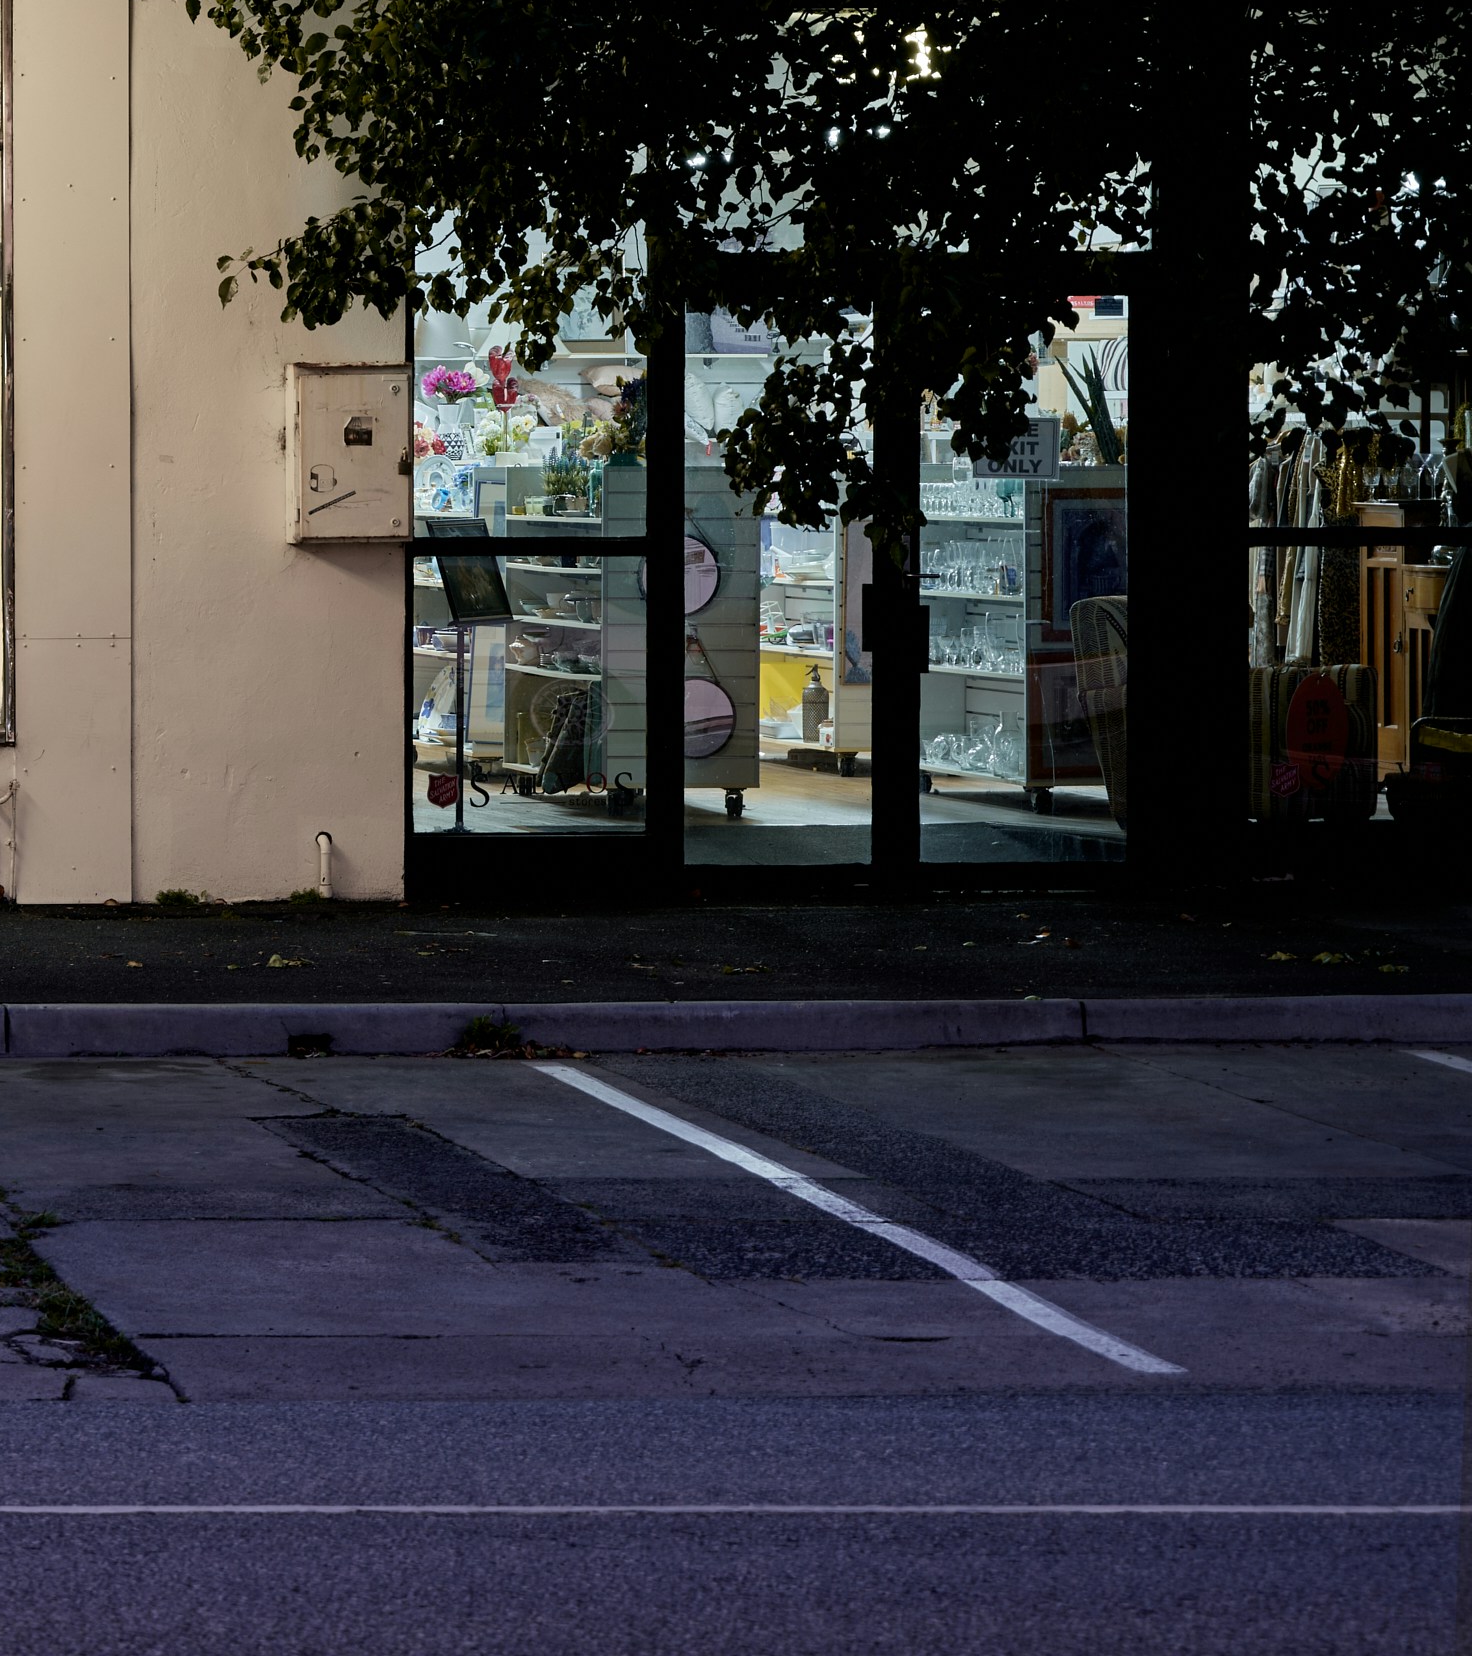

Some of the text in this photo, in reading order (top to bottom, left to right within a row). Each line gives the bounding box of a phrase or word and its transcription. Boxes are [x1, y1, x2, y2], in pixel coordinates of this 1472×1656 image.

[1003, 441, 1039, 455] XIT
[987, 459, 1043, 473] ONLY
[1306, 718, 1329, 736] OFF
[1274, 764, 1287, 776] THE
[434, 776, 446, 788] THE
[1280, 778, 1297, 793] ARMY
[429, 780, 457, 800] SALVATION
[438, 789, 456, 804] ARMY
[568, 797, 607, 807] stores
